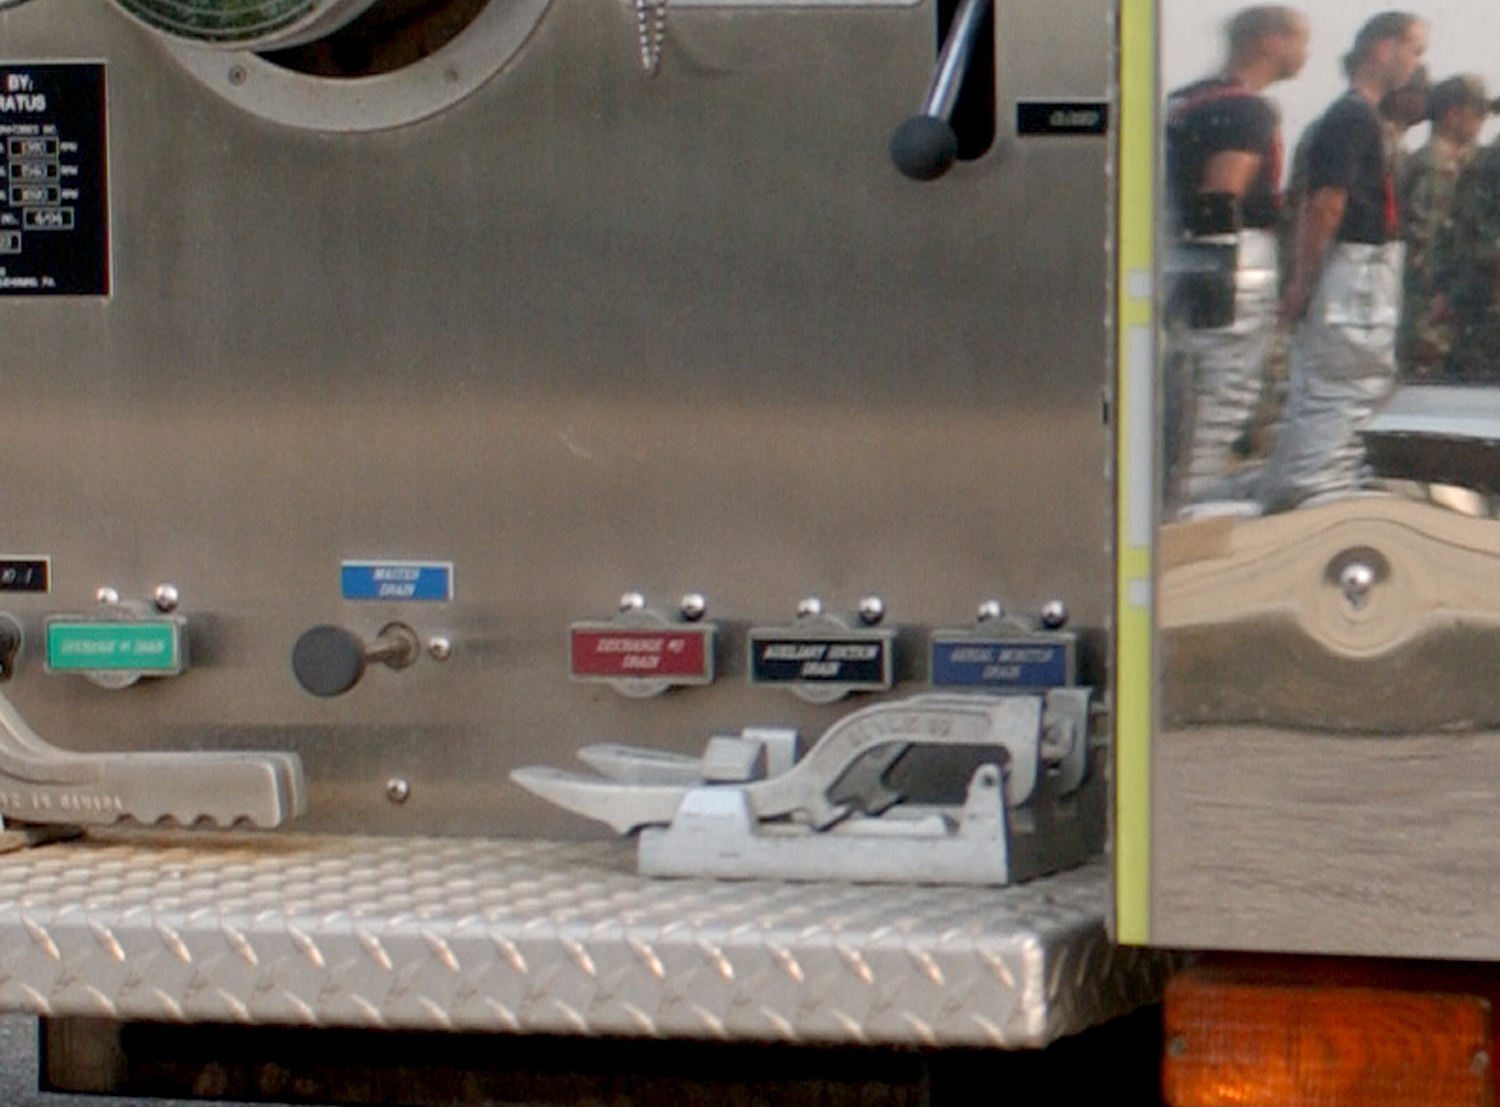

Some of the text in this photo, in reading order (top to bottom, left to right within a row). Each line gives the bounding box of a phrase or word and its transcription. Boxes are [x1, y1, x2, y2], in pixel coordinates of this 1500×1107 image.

[596, 637, 664, 653] DISCHARGE
[762, 643, 828, 661] AUXILIARY
[621, 654, 660, 669] DRAIN
[950, 647, 996, 662] AERIAL
[801, 661, 841, 677] DRAIN
[981, 664, 1020, 679] DRAIN
